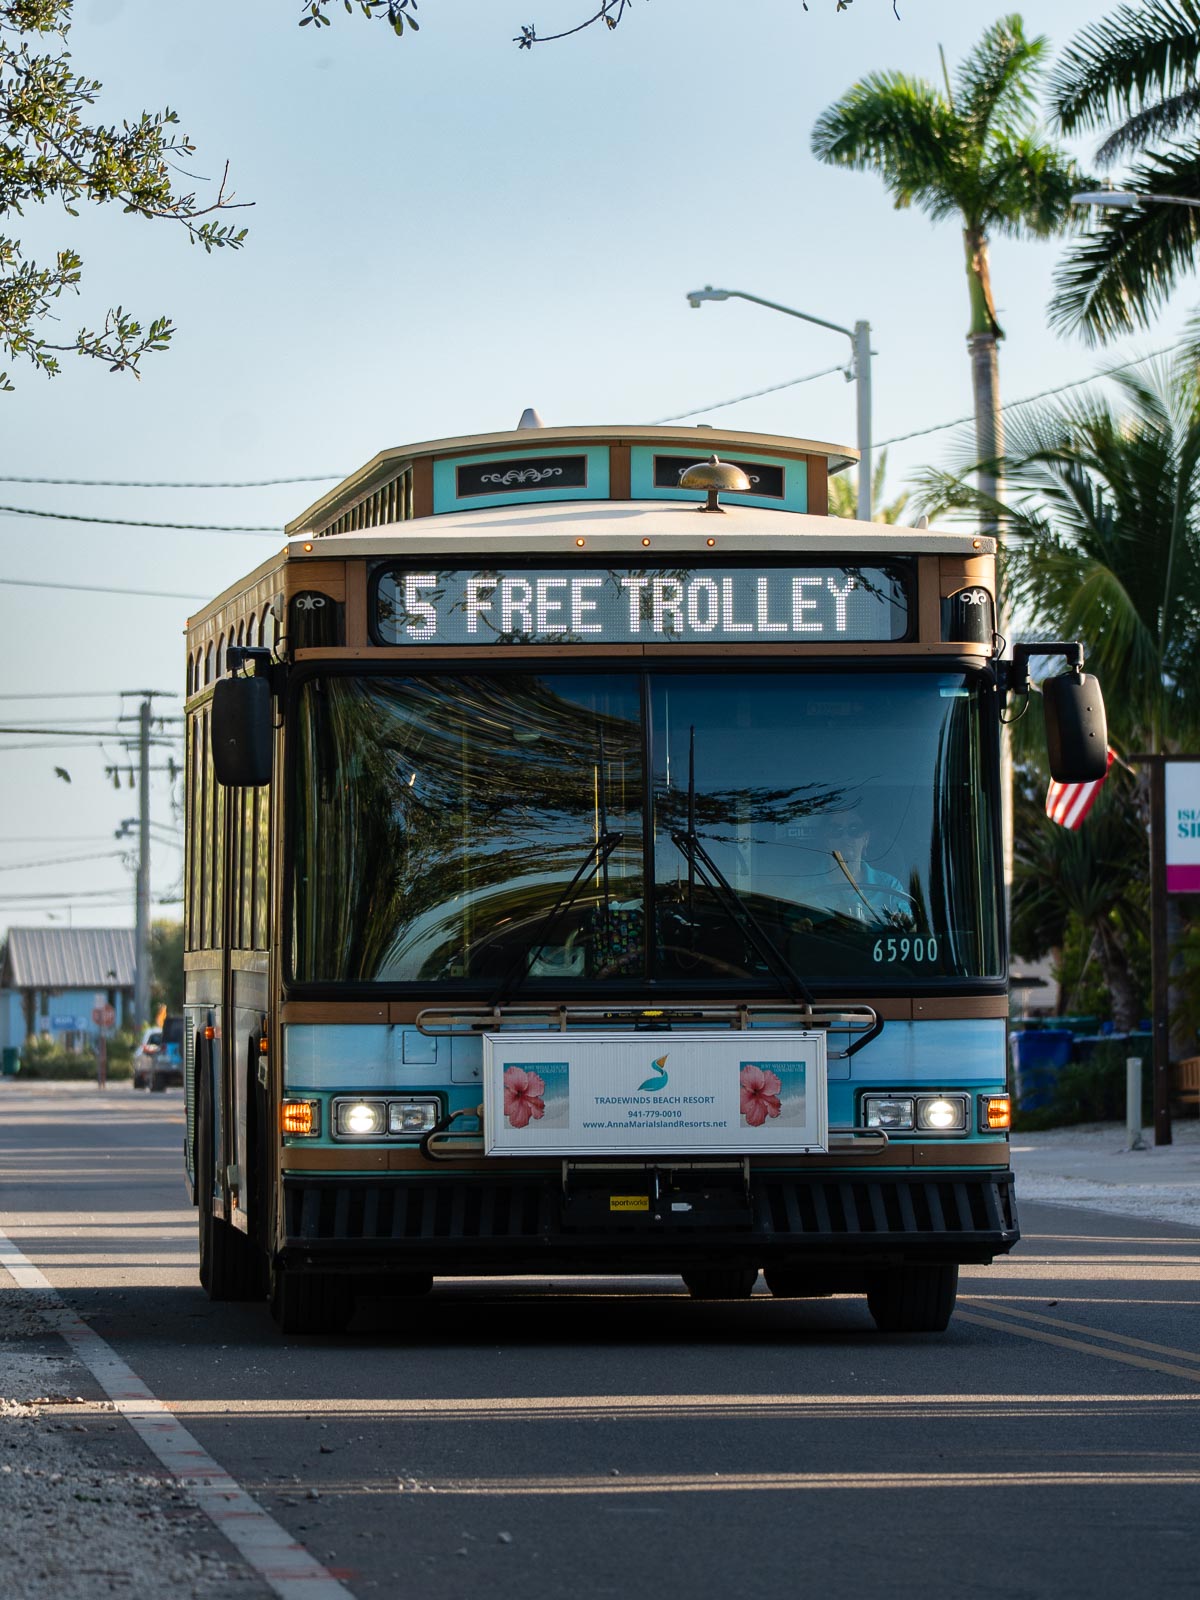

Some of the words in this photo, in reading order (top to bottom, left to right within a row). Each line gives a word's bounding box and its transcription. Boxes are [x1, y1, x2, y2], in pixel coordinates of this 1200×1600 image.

[406, 575, 437, 640] 5
[467, 577, 602, 633] FREE
[621, 577, 855, 633] TROLLEY
[873, 937, 938, 963] 65900
[594, 1096, 650, 1105] TRADEWINDS
[652, 1096, 680, 1105] BEACH
[682, 1095, 715, 1105] RESORT
[627, 1110, 682, 1118] 941-779-0010
[582, 1119, 728, 1129] www.AnnaMariaIslandResorts.net
